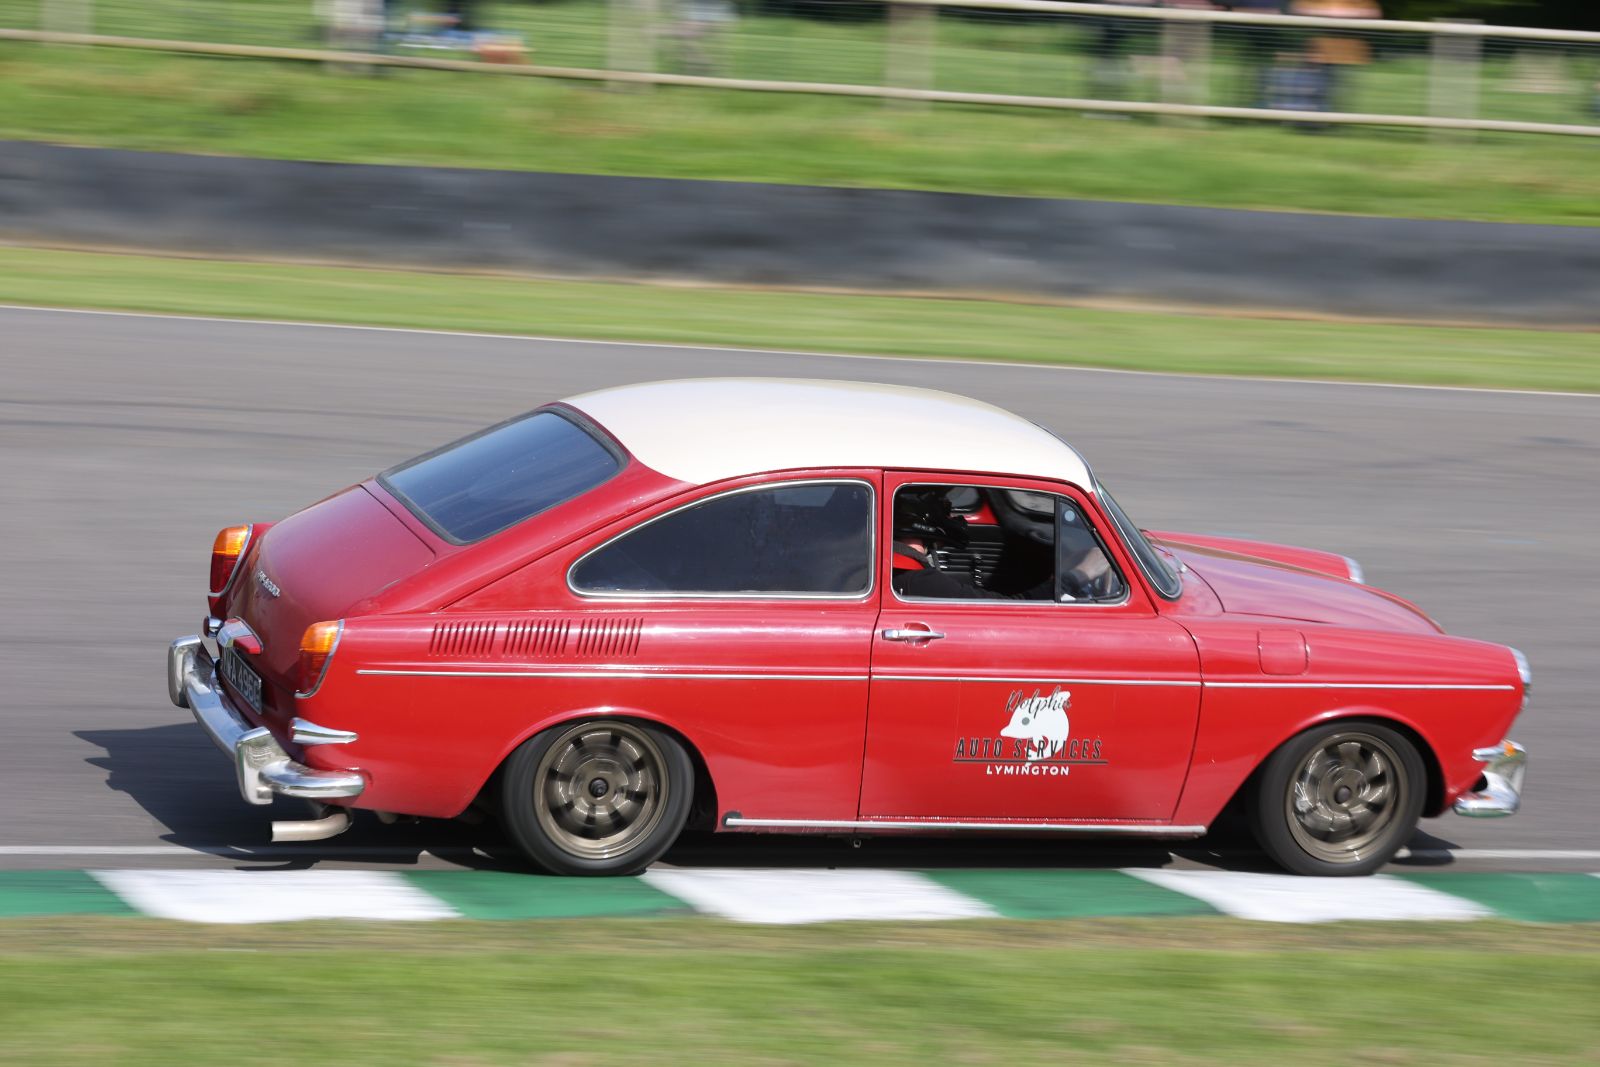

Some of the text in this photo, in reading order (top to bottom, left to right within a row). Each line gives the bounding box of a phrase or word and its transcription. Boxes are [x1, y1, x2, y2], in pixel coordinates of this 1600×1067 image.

[1005, 685, 1072, 719] Dolphin
[956, 737, 1103, 759] AUTO SERVICES
[986, 765, 1070, 776] LYMINGTON
